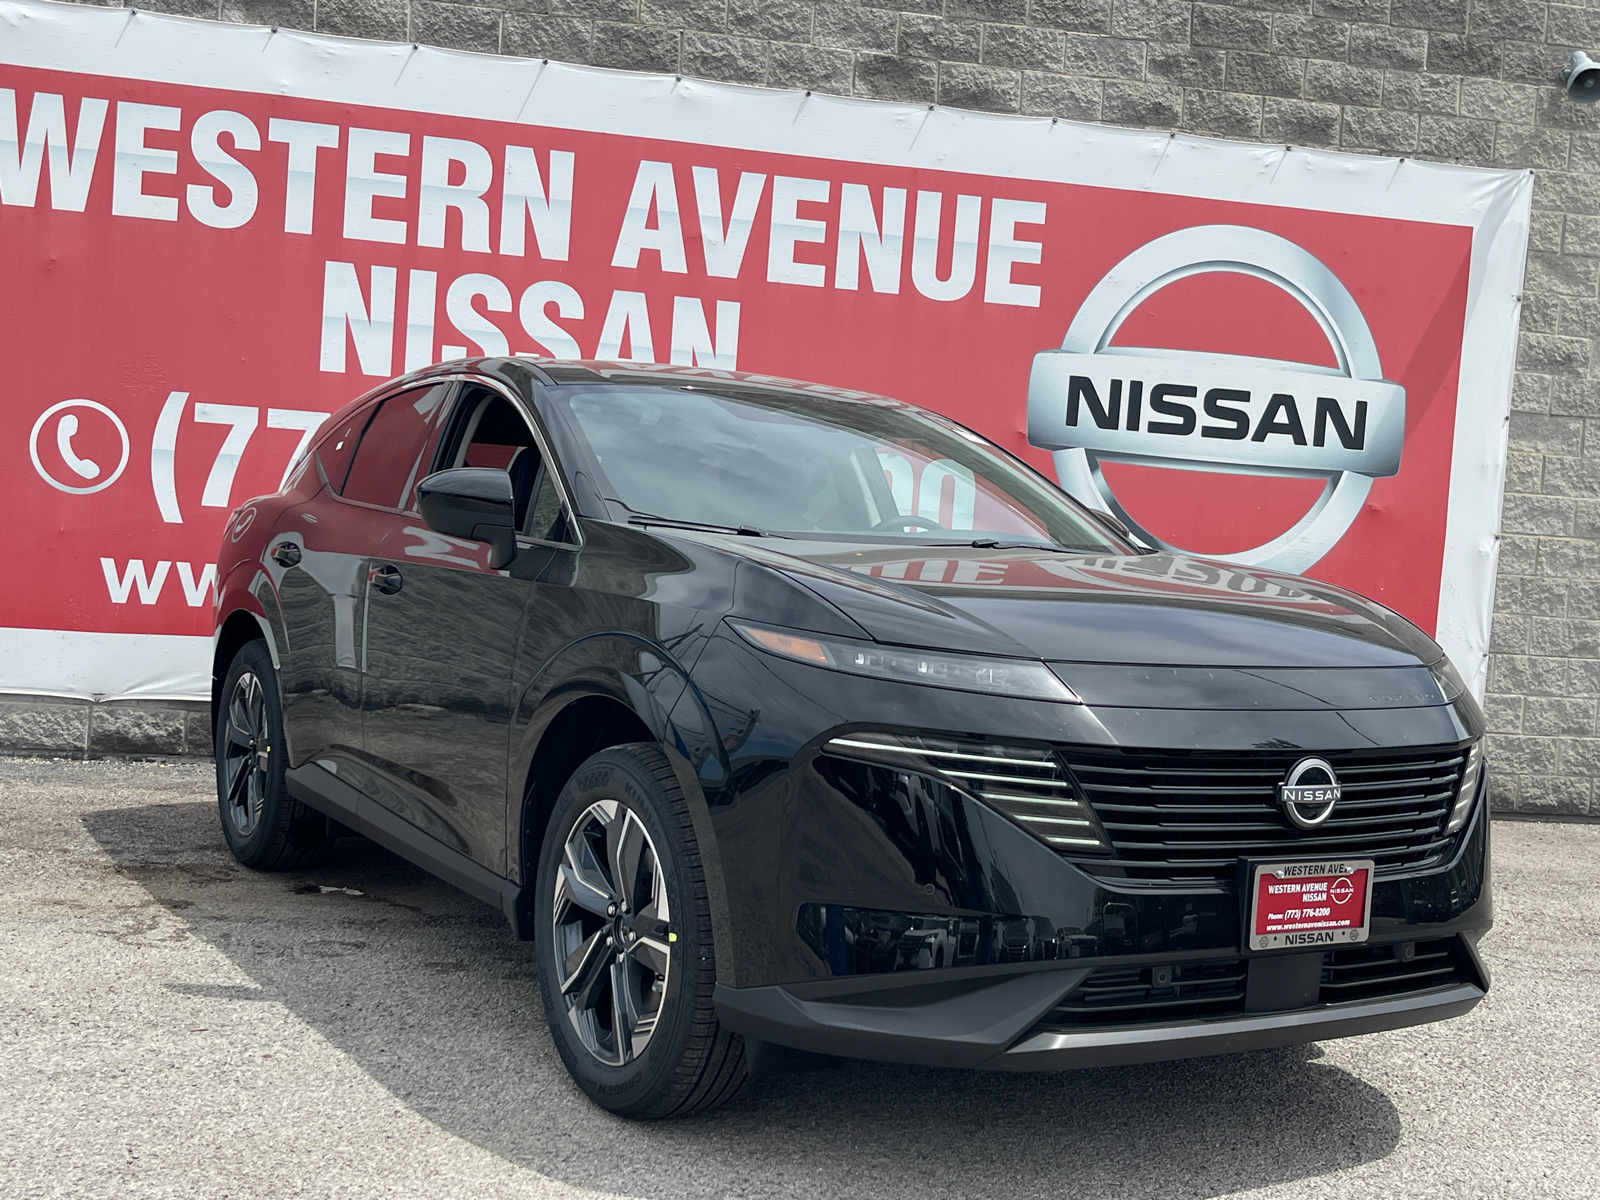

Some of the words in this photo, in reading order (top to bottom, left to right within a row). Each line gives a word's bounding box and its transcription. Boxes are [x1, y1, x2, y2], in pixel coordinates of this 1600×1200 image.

[0, 88, 575, 262] WESTERN
[611, 160, 1047, 308] AVENUE
[320, 261, 740, 377] NISSAN
[1065, 375, 1368, 451] NISSAN
[1283, 787, 1341, 801] NISSAN
[1284, 864, 1326, 876] WESTERN
[1268, 883, 1301, 894] WESTERN
[1301, 882, 1328, 893] AVENUE
[1302, 892, 1327, 903] NISSAN
[1284, 909, 1301, 920] (773)
[1301, 907, 1331, 918] 776-8200
[1266, 920, 1351, 931] www.westernavenissan.com
[1284, 931, 1334, 946] NISSAN
